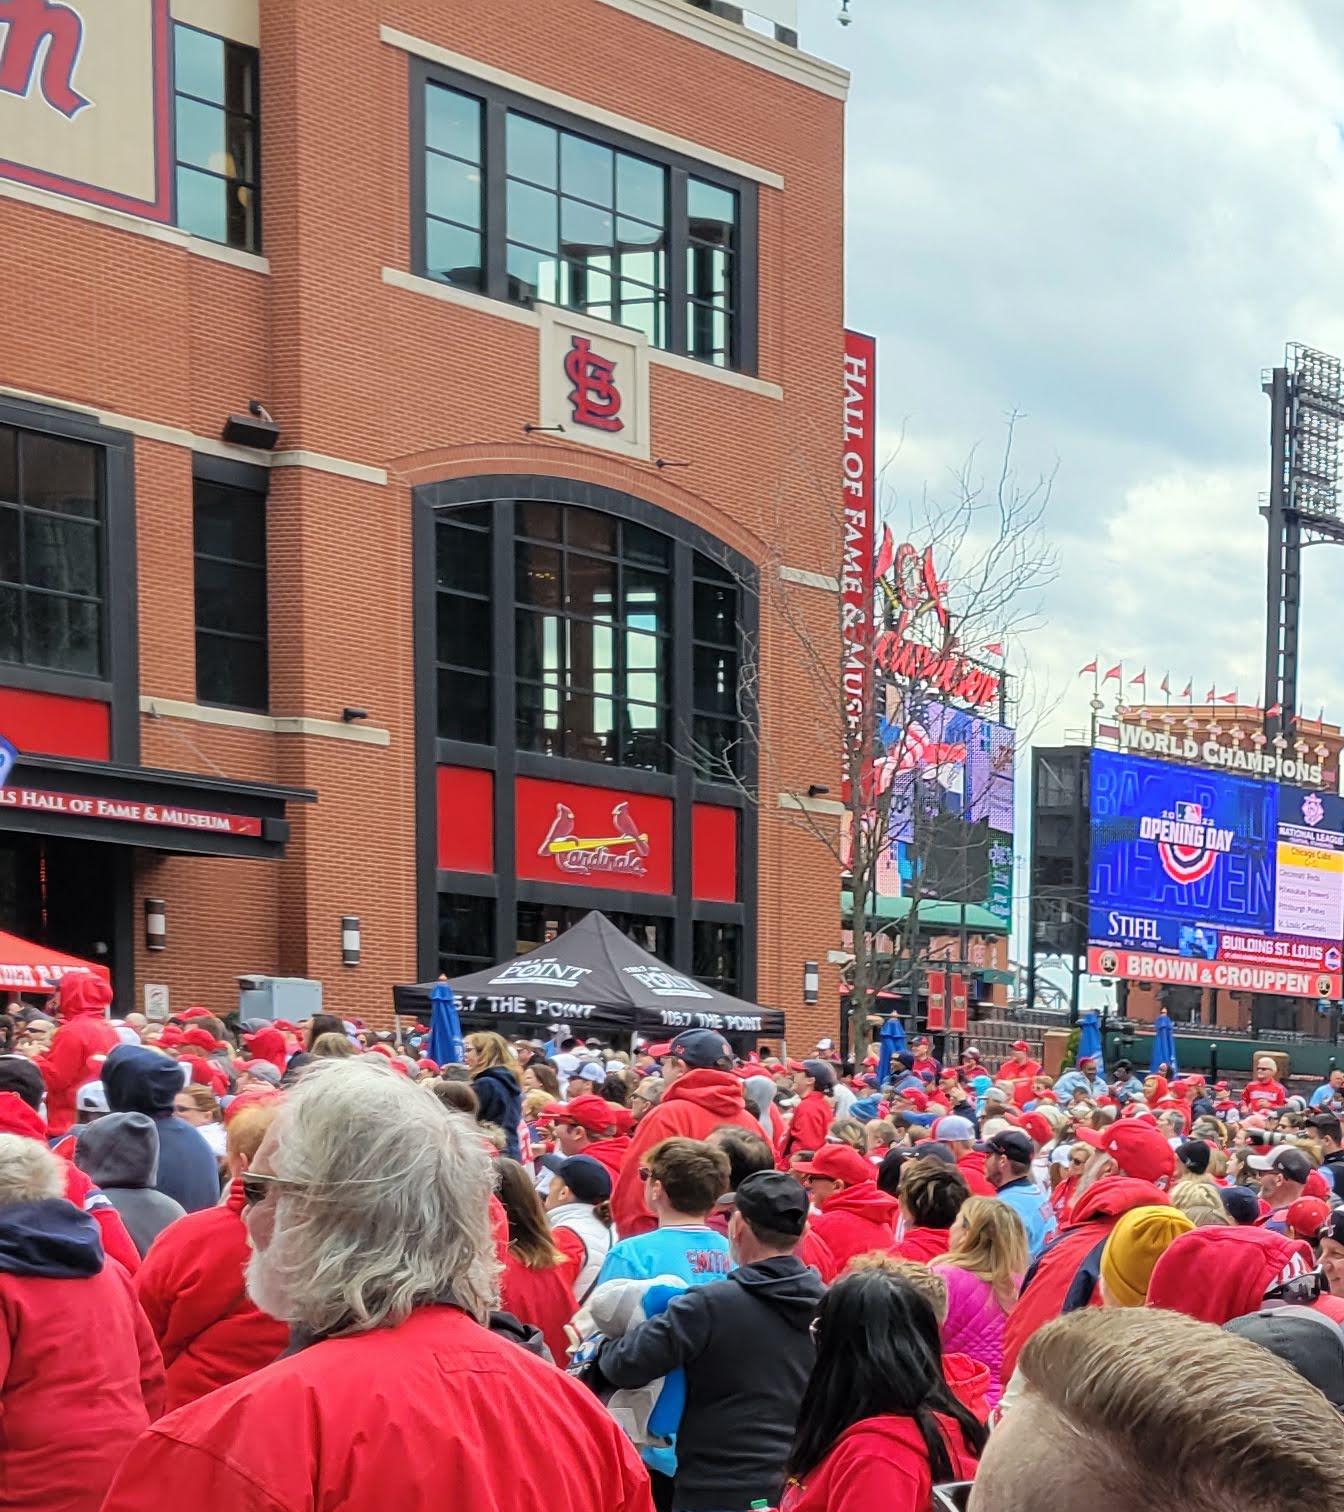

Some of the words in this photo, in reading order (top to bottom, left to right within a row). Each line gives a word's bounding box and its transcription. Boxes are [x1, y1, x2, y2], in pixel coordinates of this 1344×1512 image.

[843, 352, 867, 441] HALL
[843, 452, 865, 498] OF
[842, 508, 866, 594] FAME
[1119, 723, 1200, 759] WORLD
[1202, 741, 1323, 784] CHAMPIONS
[21, 790, 67, 811] HALL
[70, 799, 92, 813] OF
[97, 801, 140, 820] FAME
[143, 807, 159, 822] &
[162, 809, 231, 830] MUSEUM
[1139, 816, 1205, 849] OPENING
[1206, 827, 1235, 852] DAY
[1279, 826, 1315, 841] NATIONAL
[1316, 833, 1344, 845] LEAGUE
[555, 835, 648, 877] Cardinals
[1108, 911, 1161, 941] STIFEL
[1221, 936, 1273, 955] BUILDING
[1275, 942, 1290, 956] ST.
[1291, 944, 1323, 958] LOUIS
[499, 962, 592, 981] POINT
[1127, 955, 1198, 982] BROWN
[1201, 969, 1213, 983] &
[1215, 966, 1311, 993] CROUPPEN
[490, 996, 526, 1015] THE
[536, 1000, 596, 1019] POINT
[660, 1010, 691, 1027] 105.7
[695, 1013, 723, 1029] THE
[727, 1015, 762, 1031] POINT
